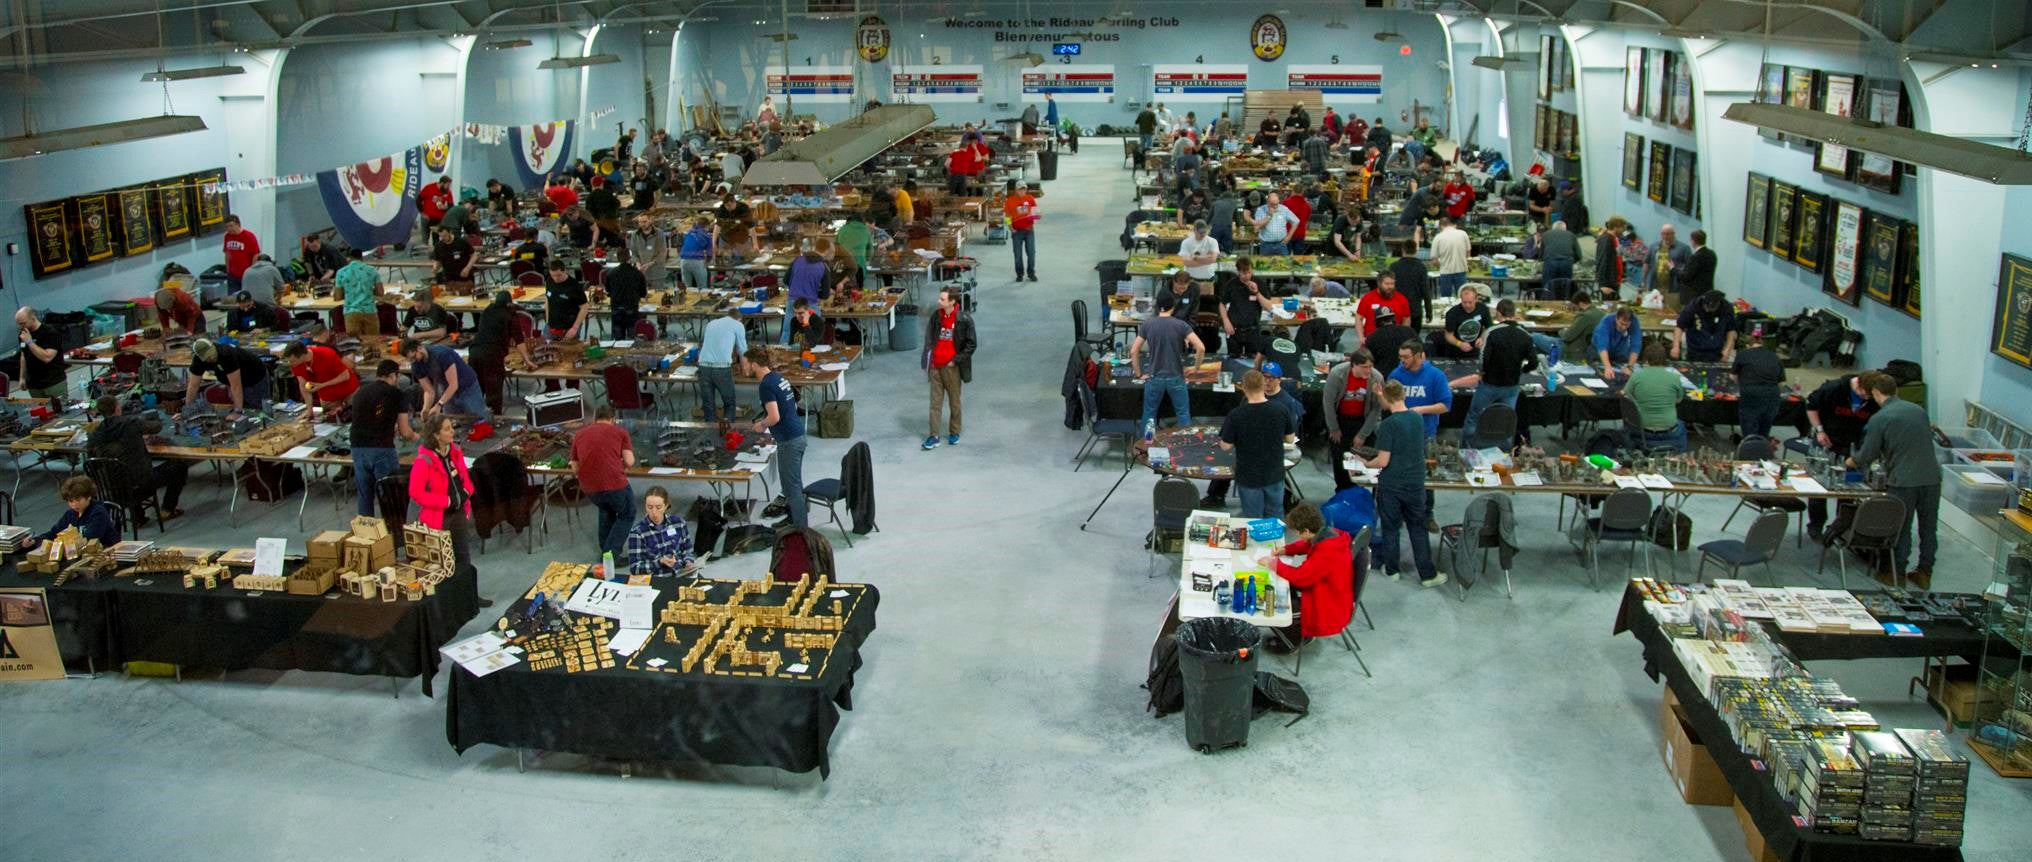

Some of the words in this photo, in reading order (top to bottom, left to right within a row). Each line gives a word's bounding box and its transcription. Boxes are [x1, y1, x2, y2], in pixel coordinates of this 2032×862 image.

[945, 17, 1003, 28] Welcome
[1007, 19, 1021, 28] to
[1024, 18, 1045, 28] the
[1150, 17, 1180, 27] Club
[995, 31, 1066, 42] Bienvenu
[932, 56, 942, 65] 2
[1063, 54, 1072, 65] 3
[1195, 54, 1204, 64] 4
[1331, 55, 1340, 65] 5
[408, 149, 417, 198] RIDEAU
